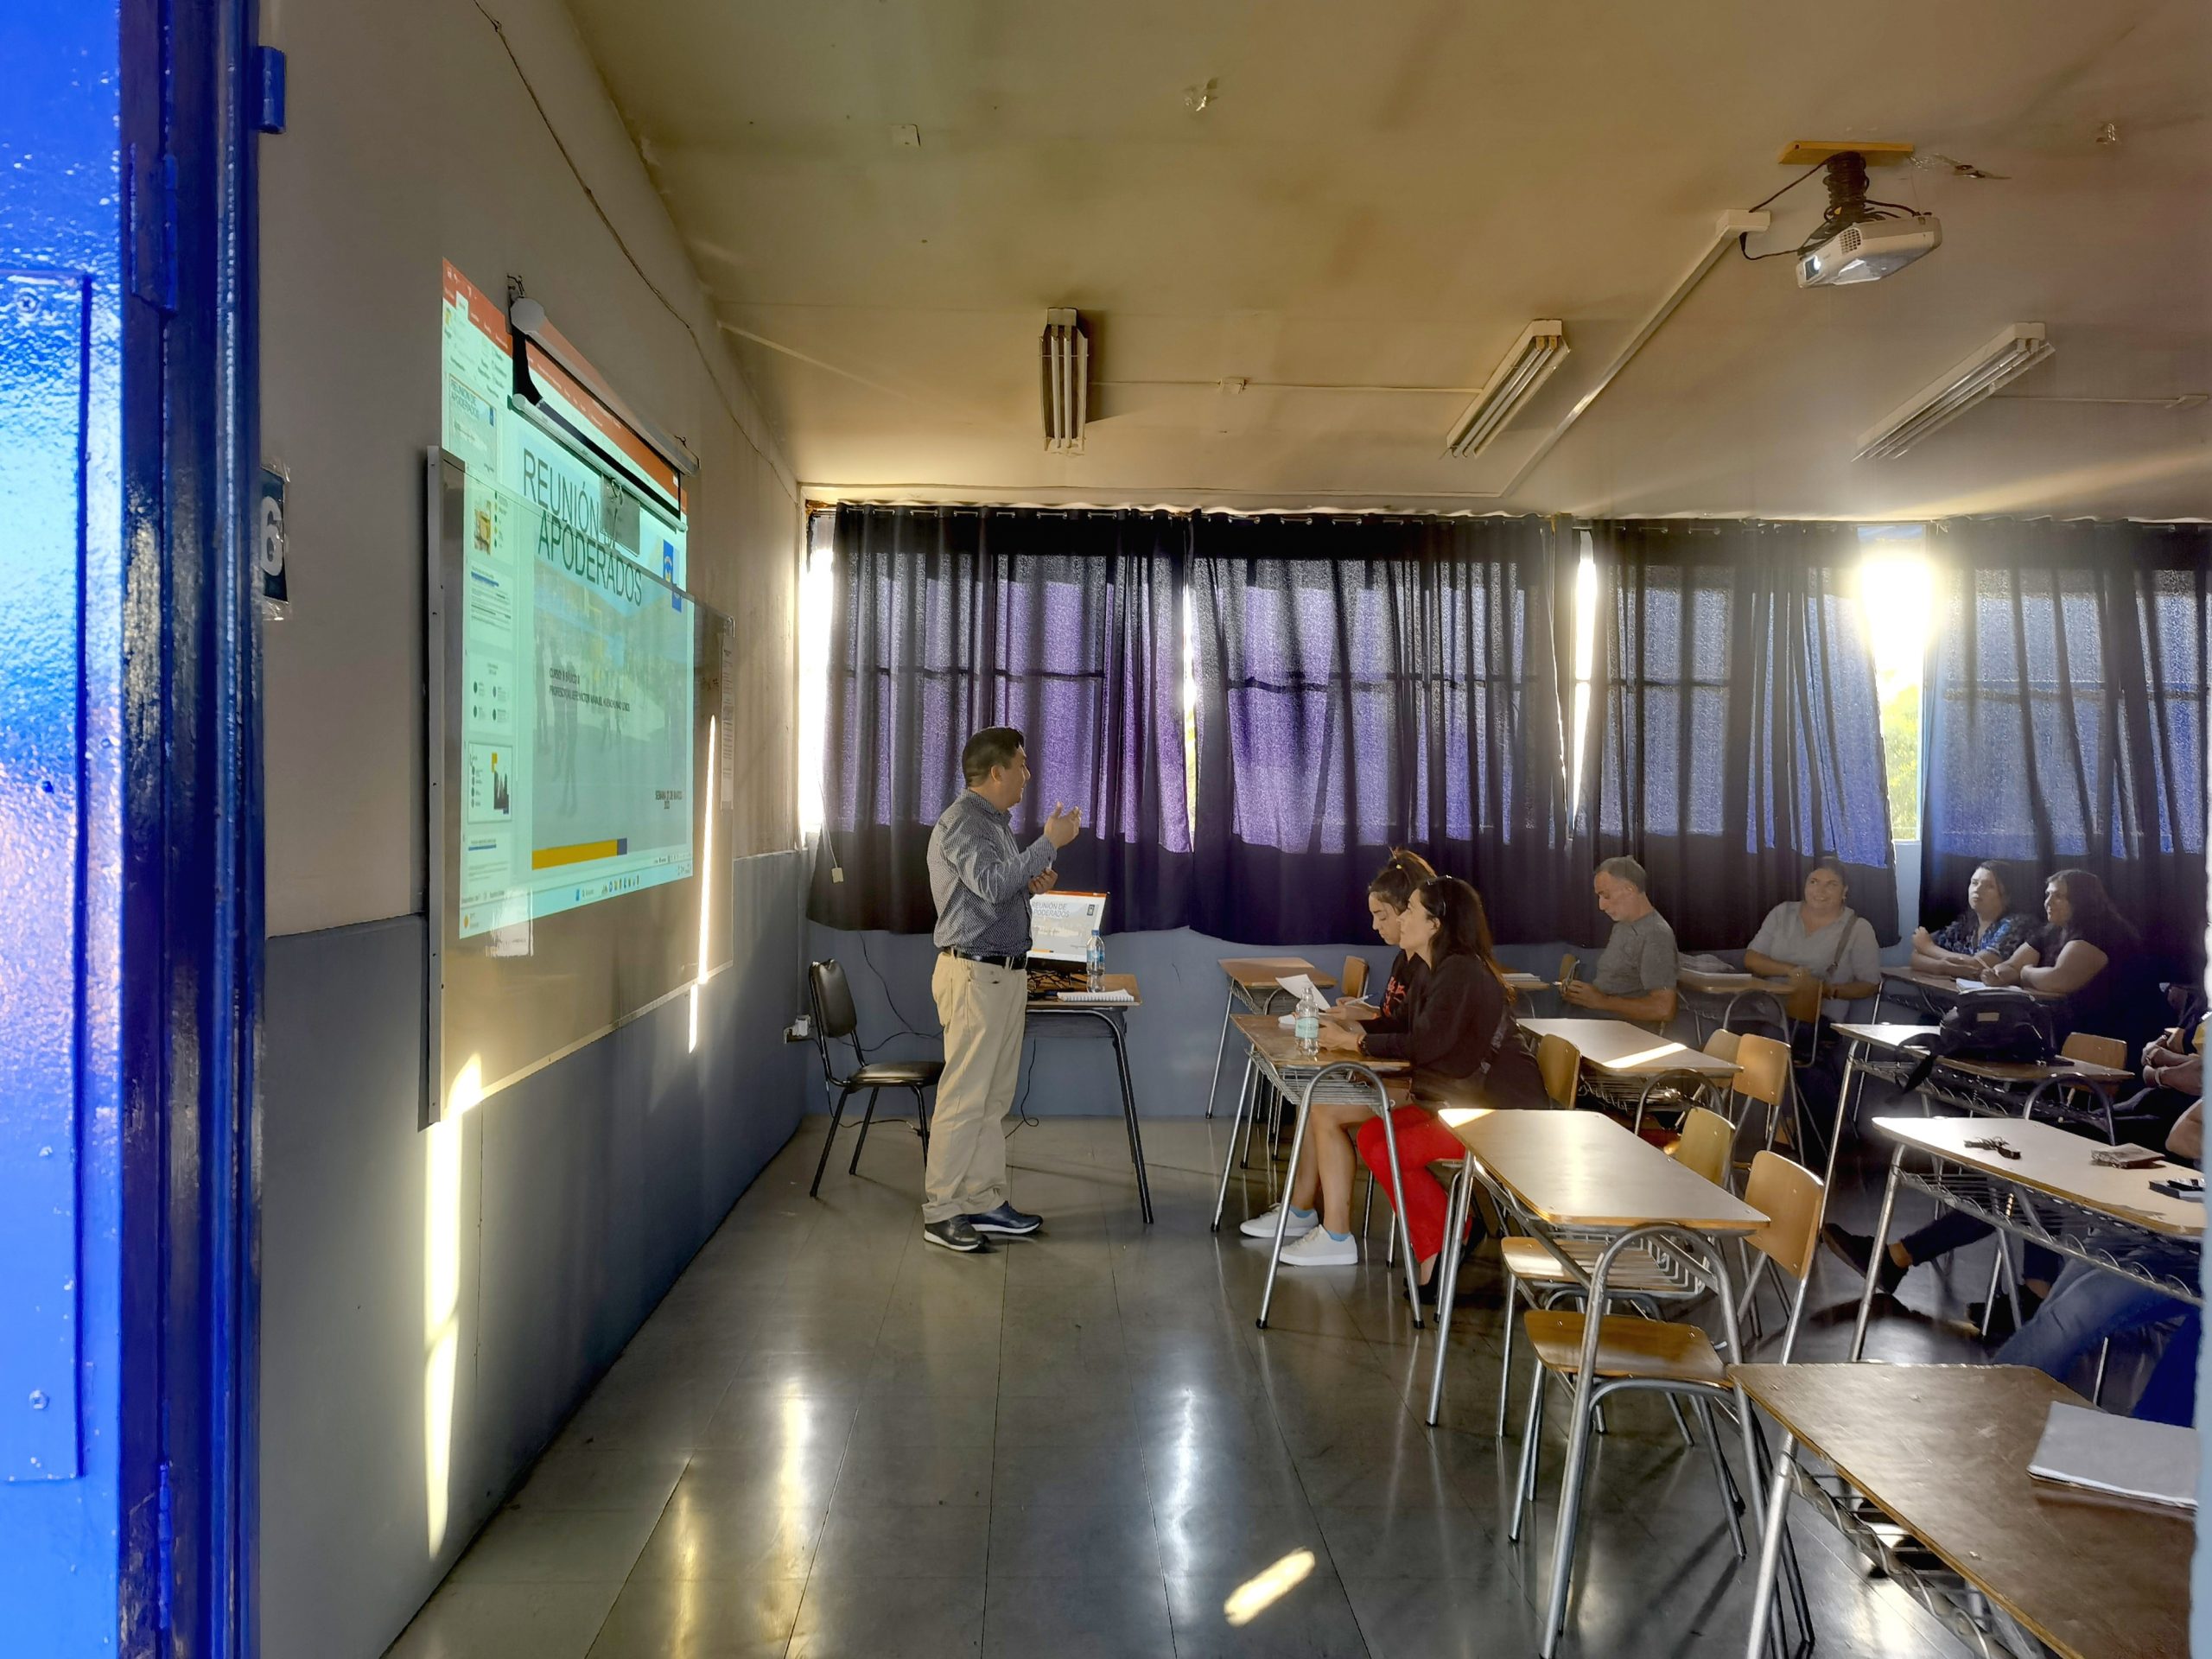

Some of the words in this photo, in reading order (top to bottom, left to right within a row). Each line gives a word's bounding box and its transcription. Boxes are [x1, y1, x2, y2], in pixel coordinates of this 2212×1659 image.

[260, 496, 283, 576] 6
[524, 448, 600, 542] REUNIÓN
[537, 511, 642, 606] APODERADOS
[1033, 909, 1070, 918] PODERADOS
